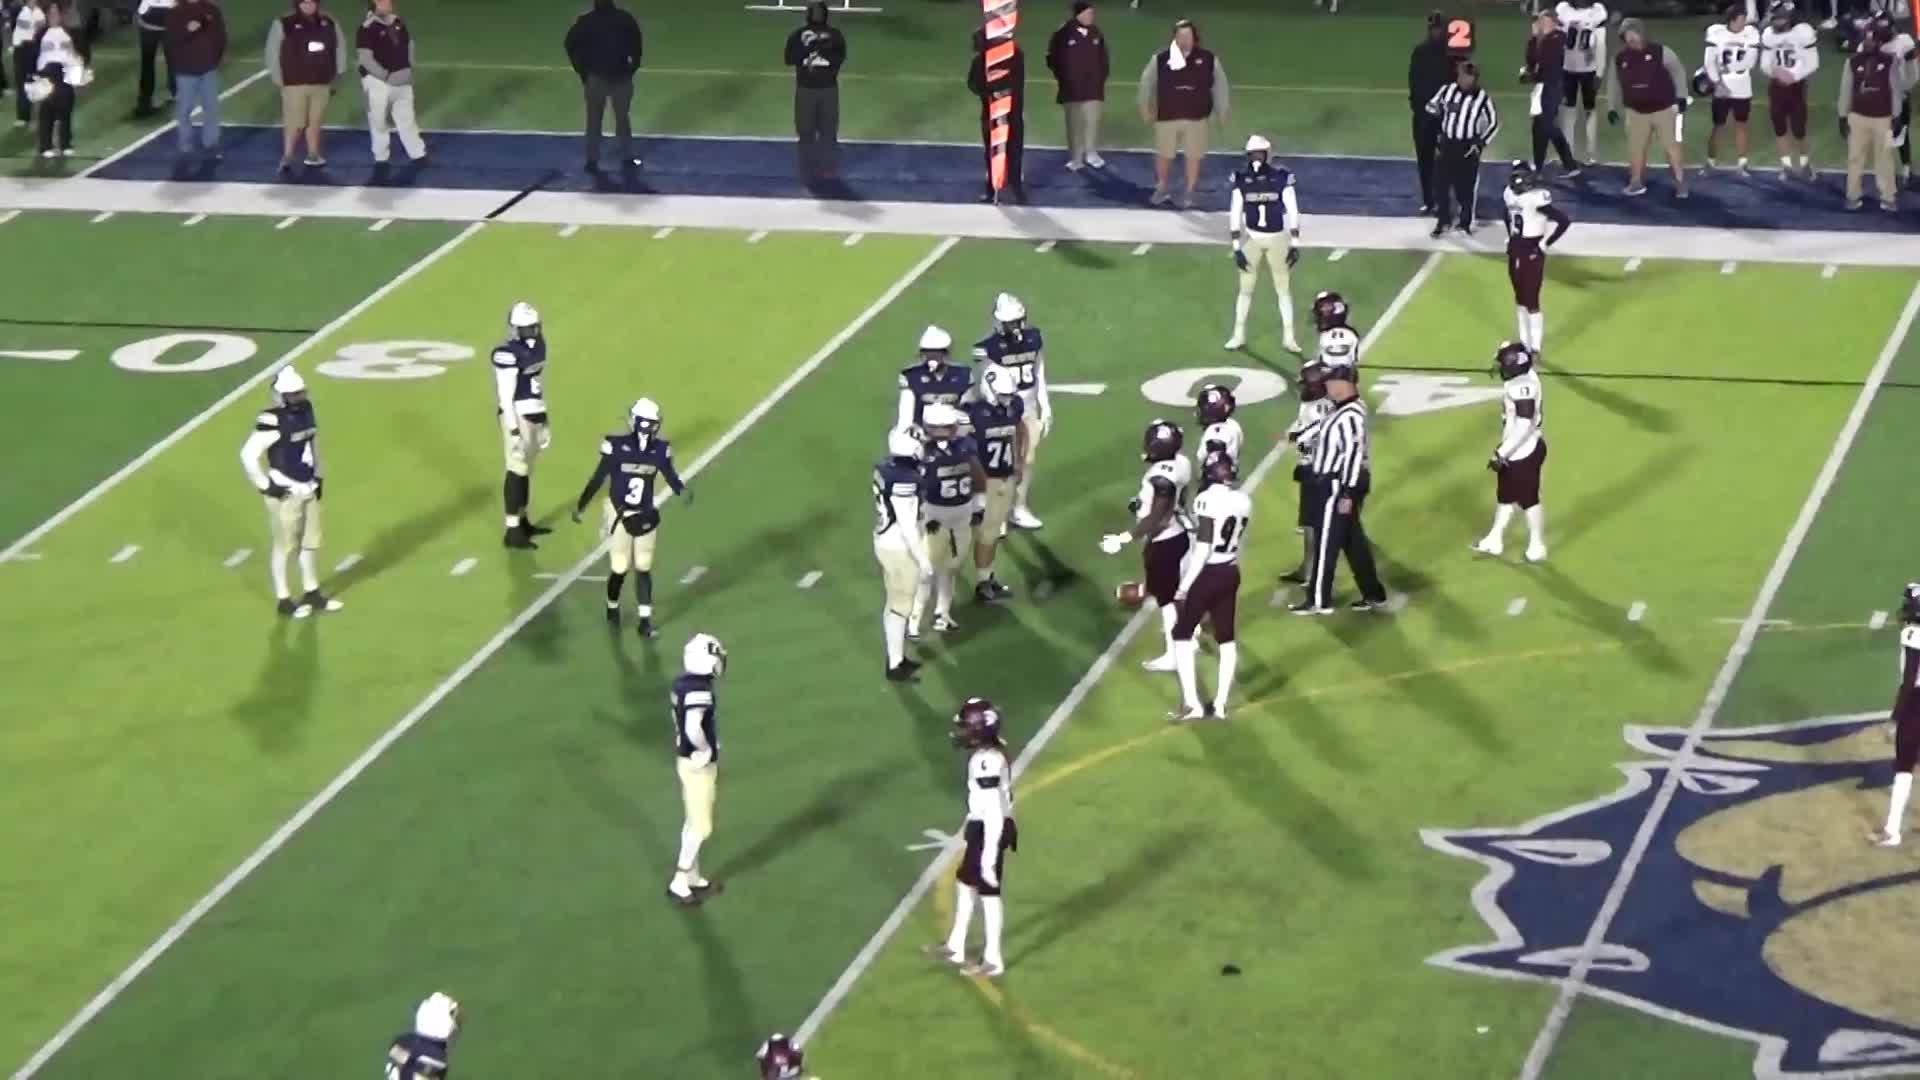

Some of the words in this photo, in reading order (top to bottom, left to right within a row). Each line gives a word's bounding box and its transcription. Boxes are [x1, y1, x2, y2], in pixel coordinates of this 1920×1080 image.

[1448, 20, 1471, 47] 2
[1257, 204, 1267, 227] 1
[624, 477, 645, 505] 3
